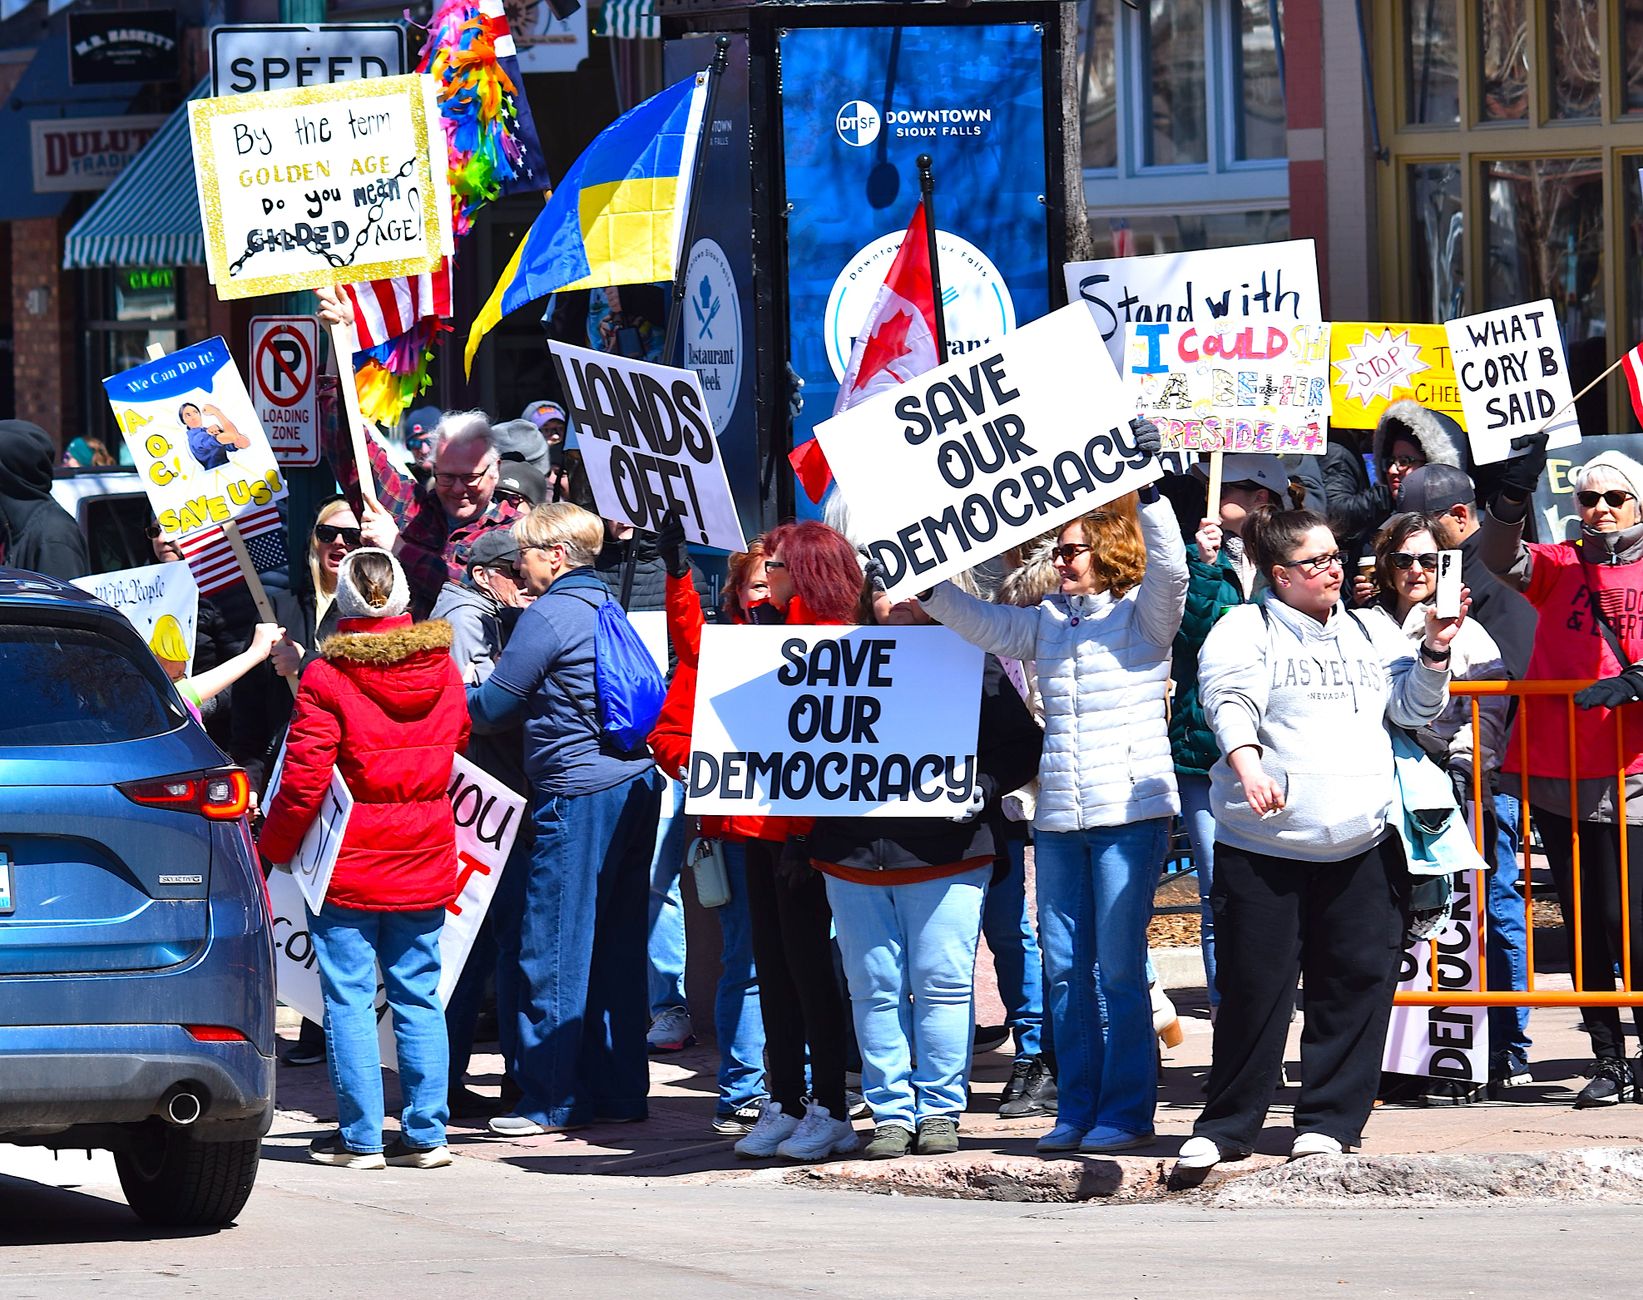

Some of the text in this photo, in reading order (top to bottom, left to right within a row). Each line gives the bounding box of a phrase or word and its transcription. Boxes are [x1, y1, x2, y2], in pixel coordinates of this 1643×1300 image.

[233, 109, 391, 155] By the term
[886, 109, 991, 124] DOWNTOWN
[896, 126, 982, 137] SIOUX FALLS
[44, 128, 155, 177] DULUT
[239, 156, 391, 187] GOLDEN AGE
[304, 188, 341, 218] you
[353, 178, 400, 207] mean
[247, 220, 350, 252] GILDED
[961, 251, 987, 277] Falls
[1205, 269, 1299, 320] with
[1132, 323, 1170, 374] I
[1355, 346, 1455, 388] STOP T
[1461, 346, 1559, 393] CORY B
[127, 351, 215, 394] We Can Do It!
[1152, 372, 1192, 410] A
[262, 408, 310, 424] LOADING
[551, 352, 713, 464] HANDS
[894, 353, 1021, 446] SAVE
[272, 426, 301, 440] ZONE
[937, 413, 1039, 489] OUR
[158, 494, 231, 533] SAVE
[609, 444, 709, 545] OFF!
[867, 418, 1152, 590] DEMOCRACY
[777, 637, 896, 687] SAVE
[1271, 659, 1311, 690] LAS
[1309, 691, 1346, 700] NEVADA
[788, 694, 881, 744] OUR
[689, 751, 975, 803] DEMOCRACY
